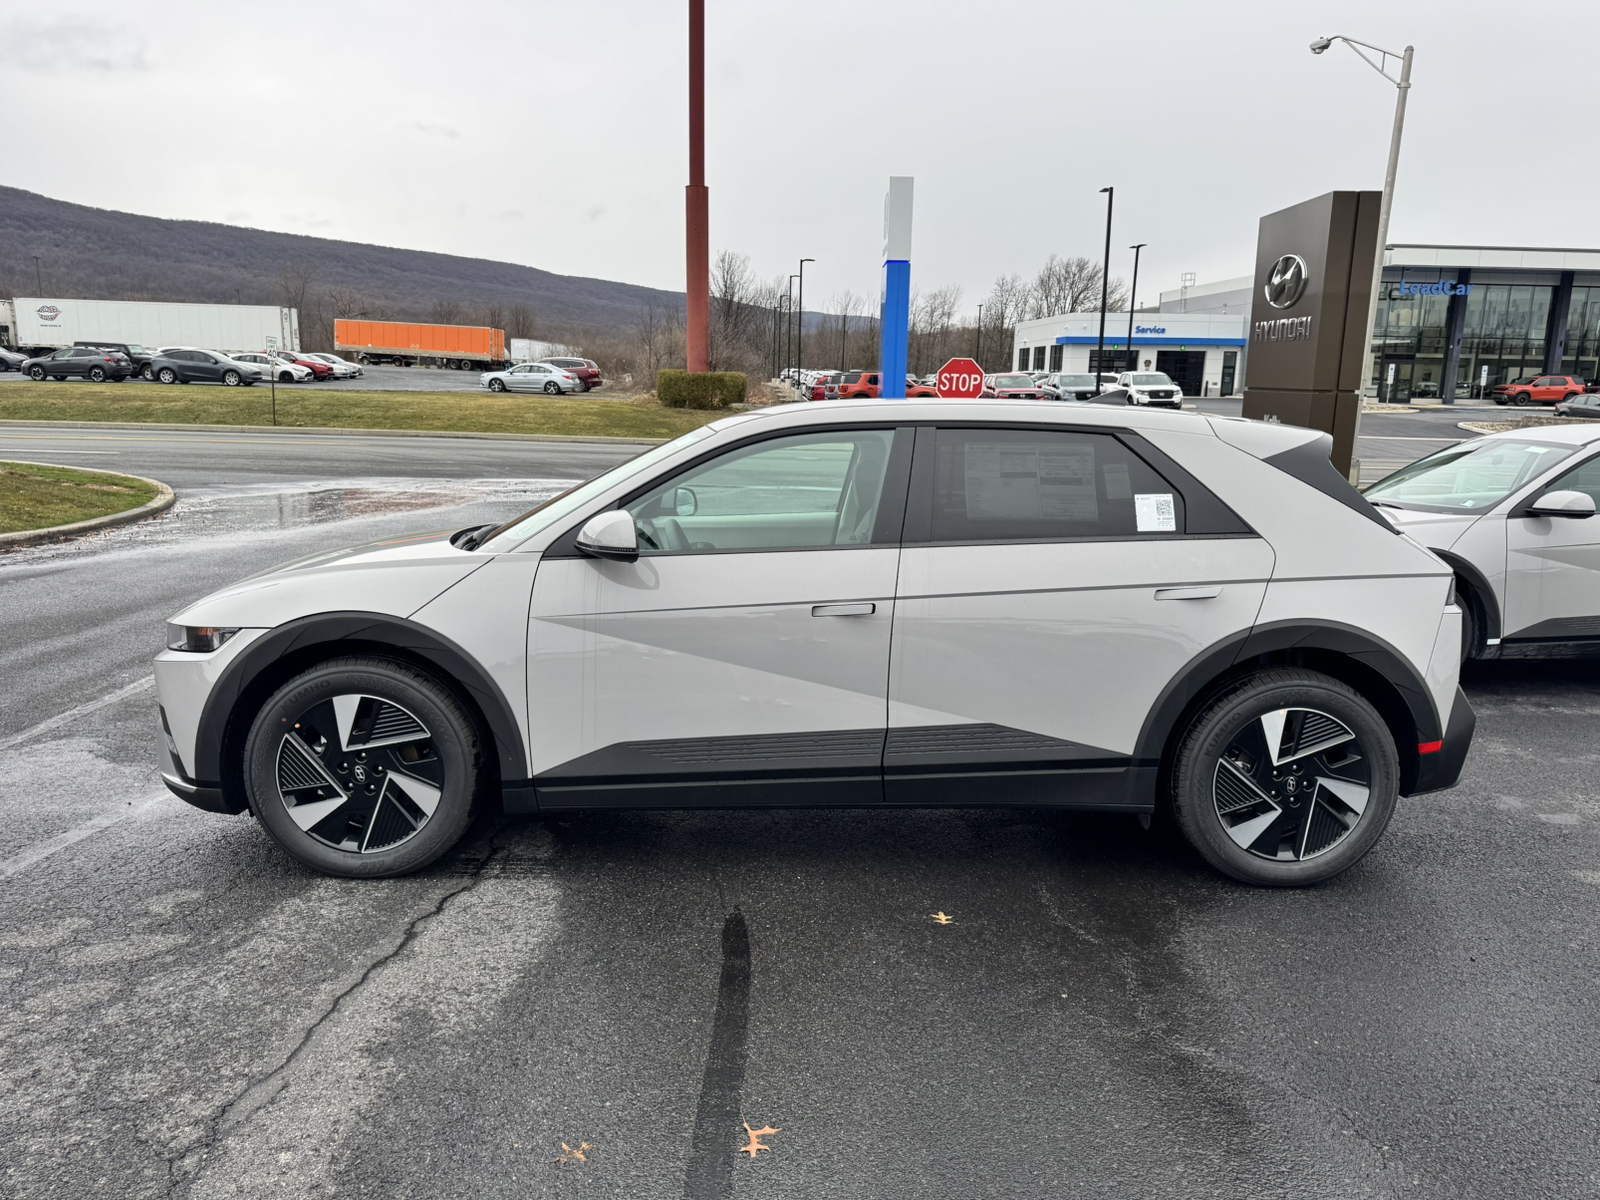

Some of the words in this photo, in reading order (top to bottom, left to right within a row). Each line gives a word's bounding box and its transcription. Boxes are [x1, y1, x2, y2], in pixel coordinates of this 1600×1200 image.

[1135, 325, 1166, 335] Service
[1255, 316, 1312, 343] HYUNDAI
[268, 349, 277, 359] 40
[940, 373, 981, 392] STOP
[280, 679, 331, 712] KUMHO
[1204, 712, 1242, 757] KUMHO
